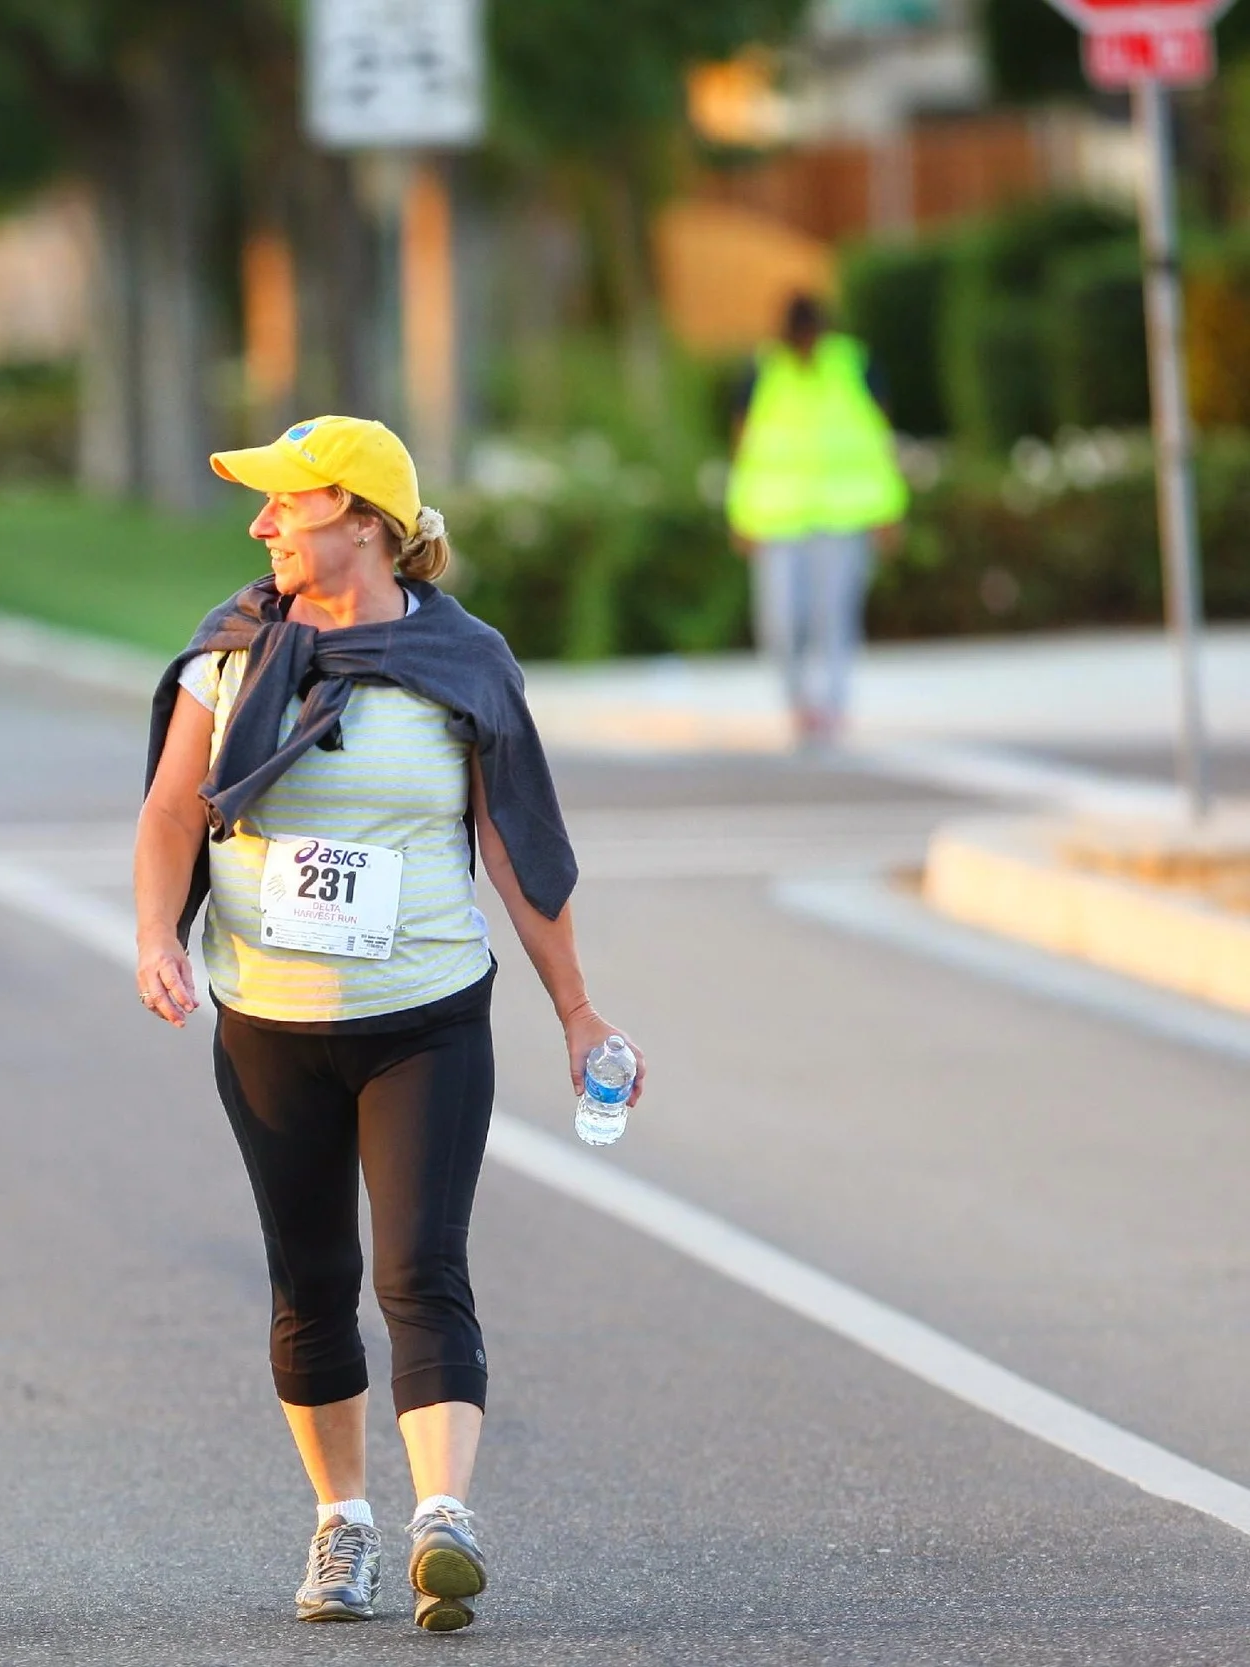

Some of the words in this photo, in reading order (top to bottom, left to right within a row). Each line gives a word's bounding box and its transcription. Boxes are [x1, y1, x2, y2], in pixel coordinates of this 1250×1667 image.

[297, 864, 357, 904] 231
[312, 902, 341, 913] DELTA
[293, 908, 337, 922] HARVEST
[337, 914, 358, 925] RUN
